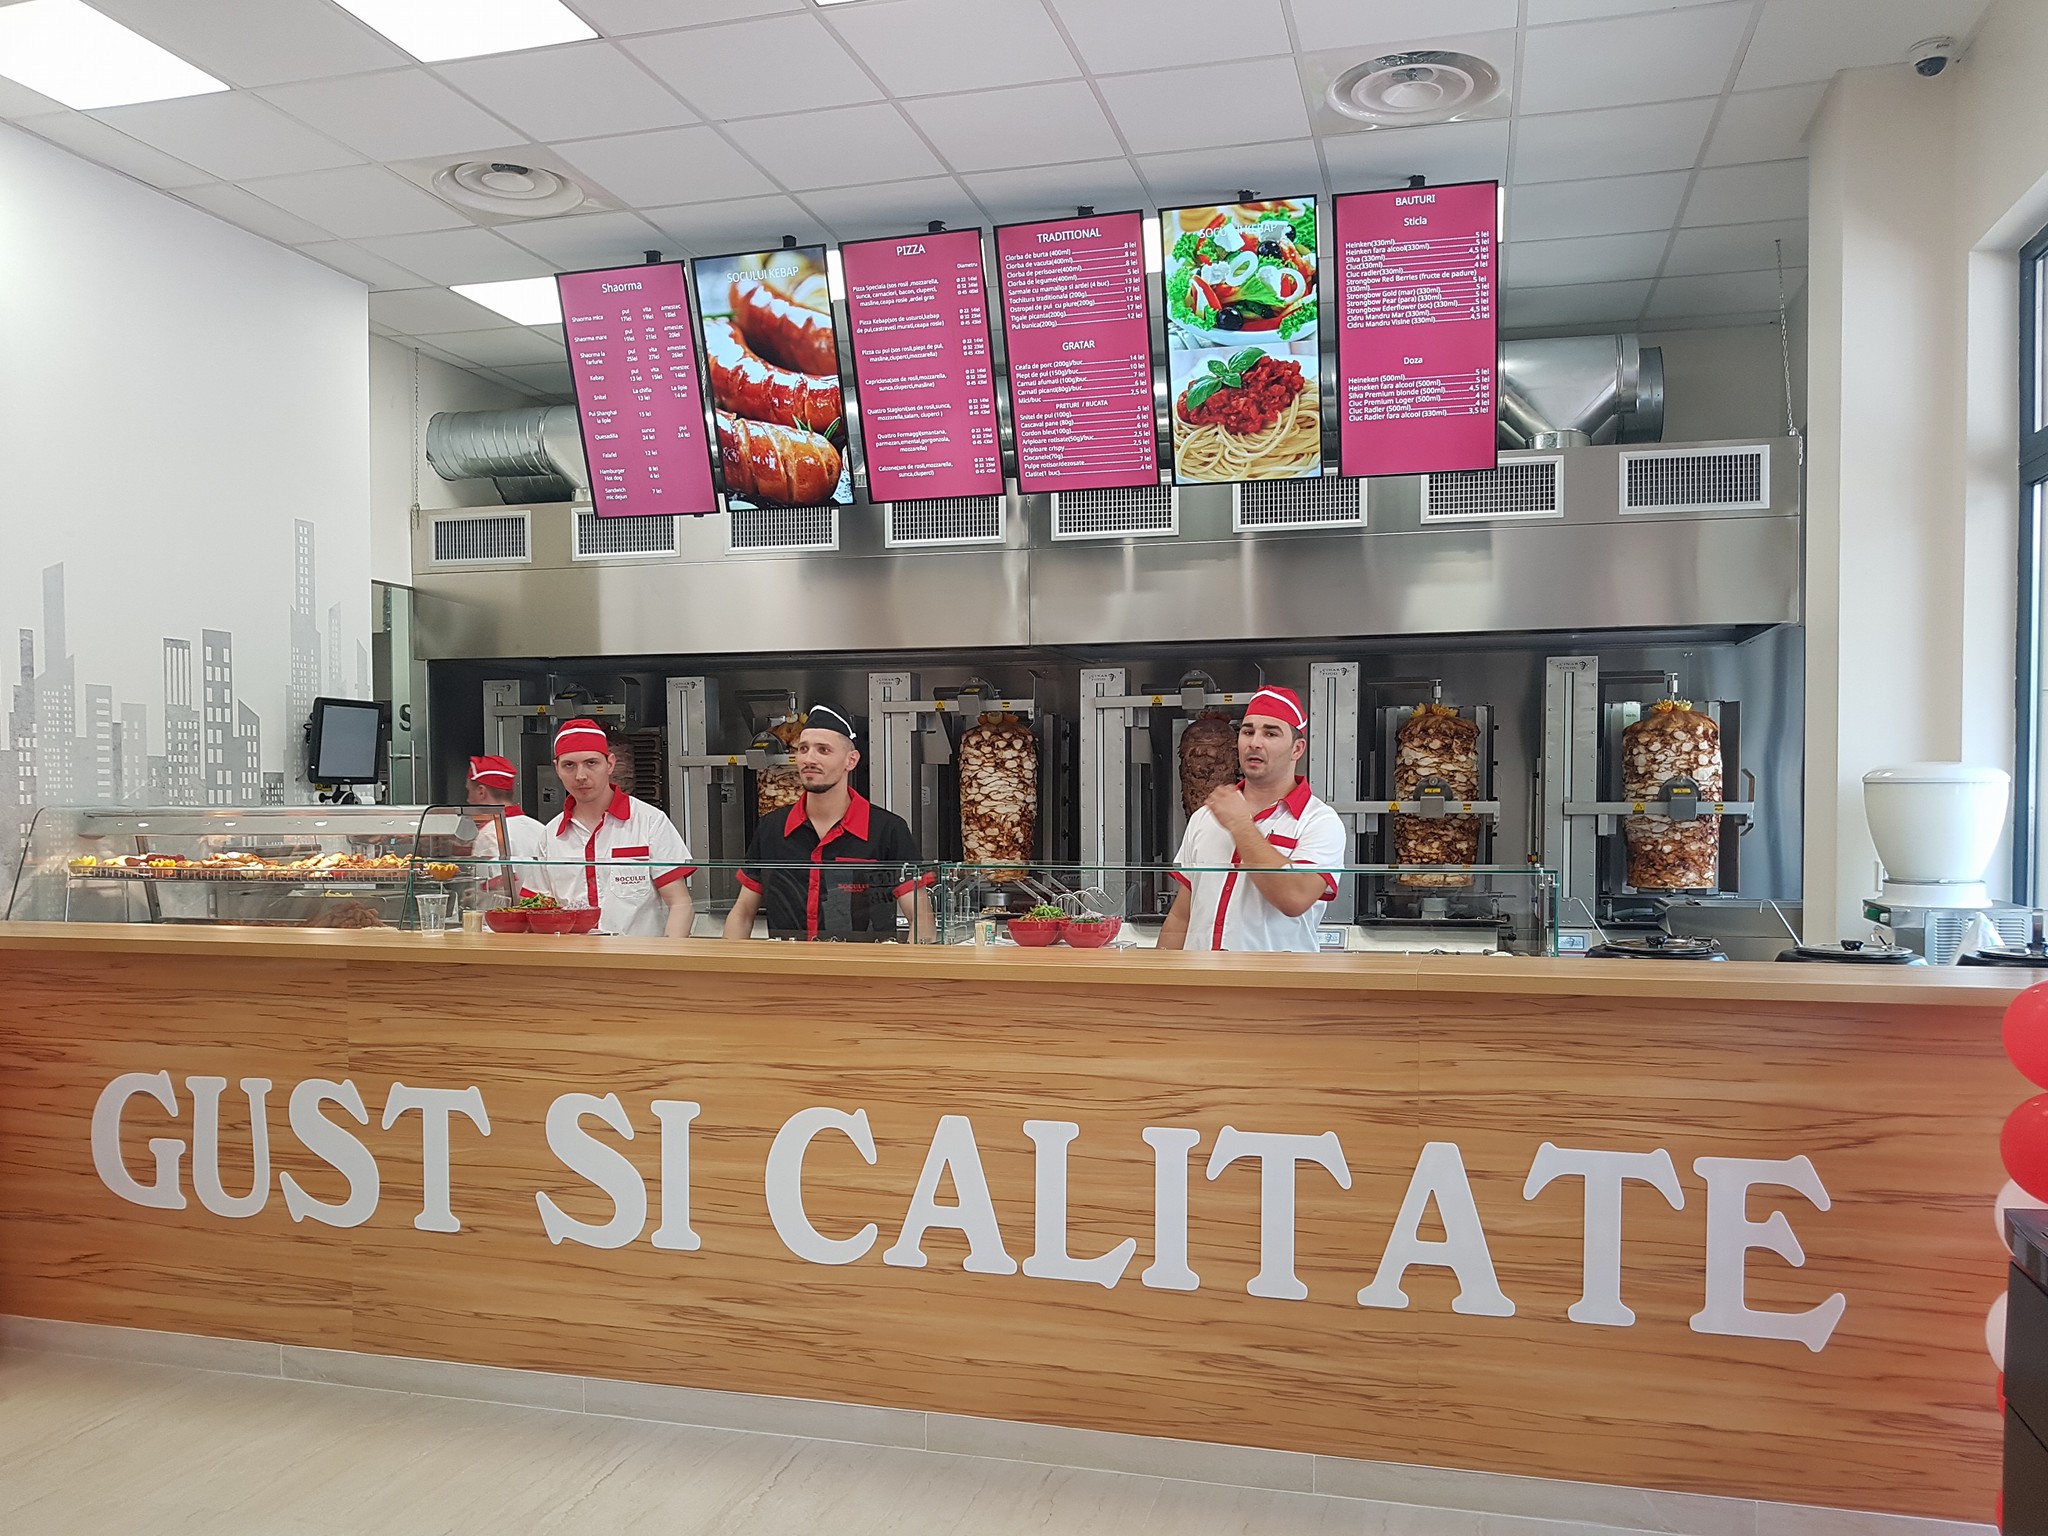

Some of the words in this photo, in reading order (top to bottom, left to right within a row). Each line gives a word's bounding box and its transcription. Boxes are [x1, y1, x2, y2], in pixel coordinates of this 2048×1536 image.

[1396, 195, 1435, 206] BAUTURI
[1404, 217, 1427, 226] Sticla
[1036, 228, 1101, 243] TRADITIONAL
[897, 244, 925, 256] PIZZA
[1049, 249, 1070, 257] (400ml)
[1362, 255, 1386, 263] (330ml)
[726, 270, 768, 283] SOCULUI
[768, 266, 799, 278] KEBAP
[1451, 269, 1477, 278] padure)
[602, 282, 642, 293] Shaorma
[1062, 341, 1095, 350] GRATAR
[91, 1070, 491, 1232] GUST
[535, 1092, 702, 1250] SI
[764, 1107, 1846, 1352] CALITATE
